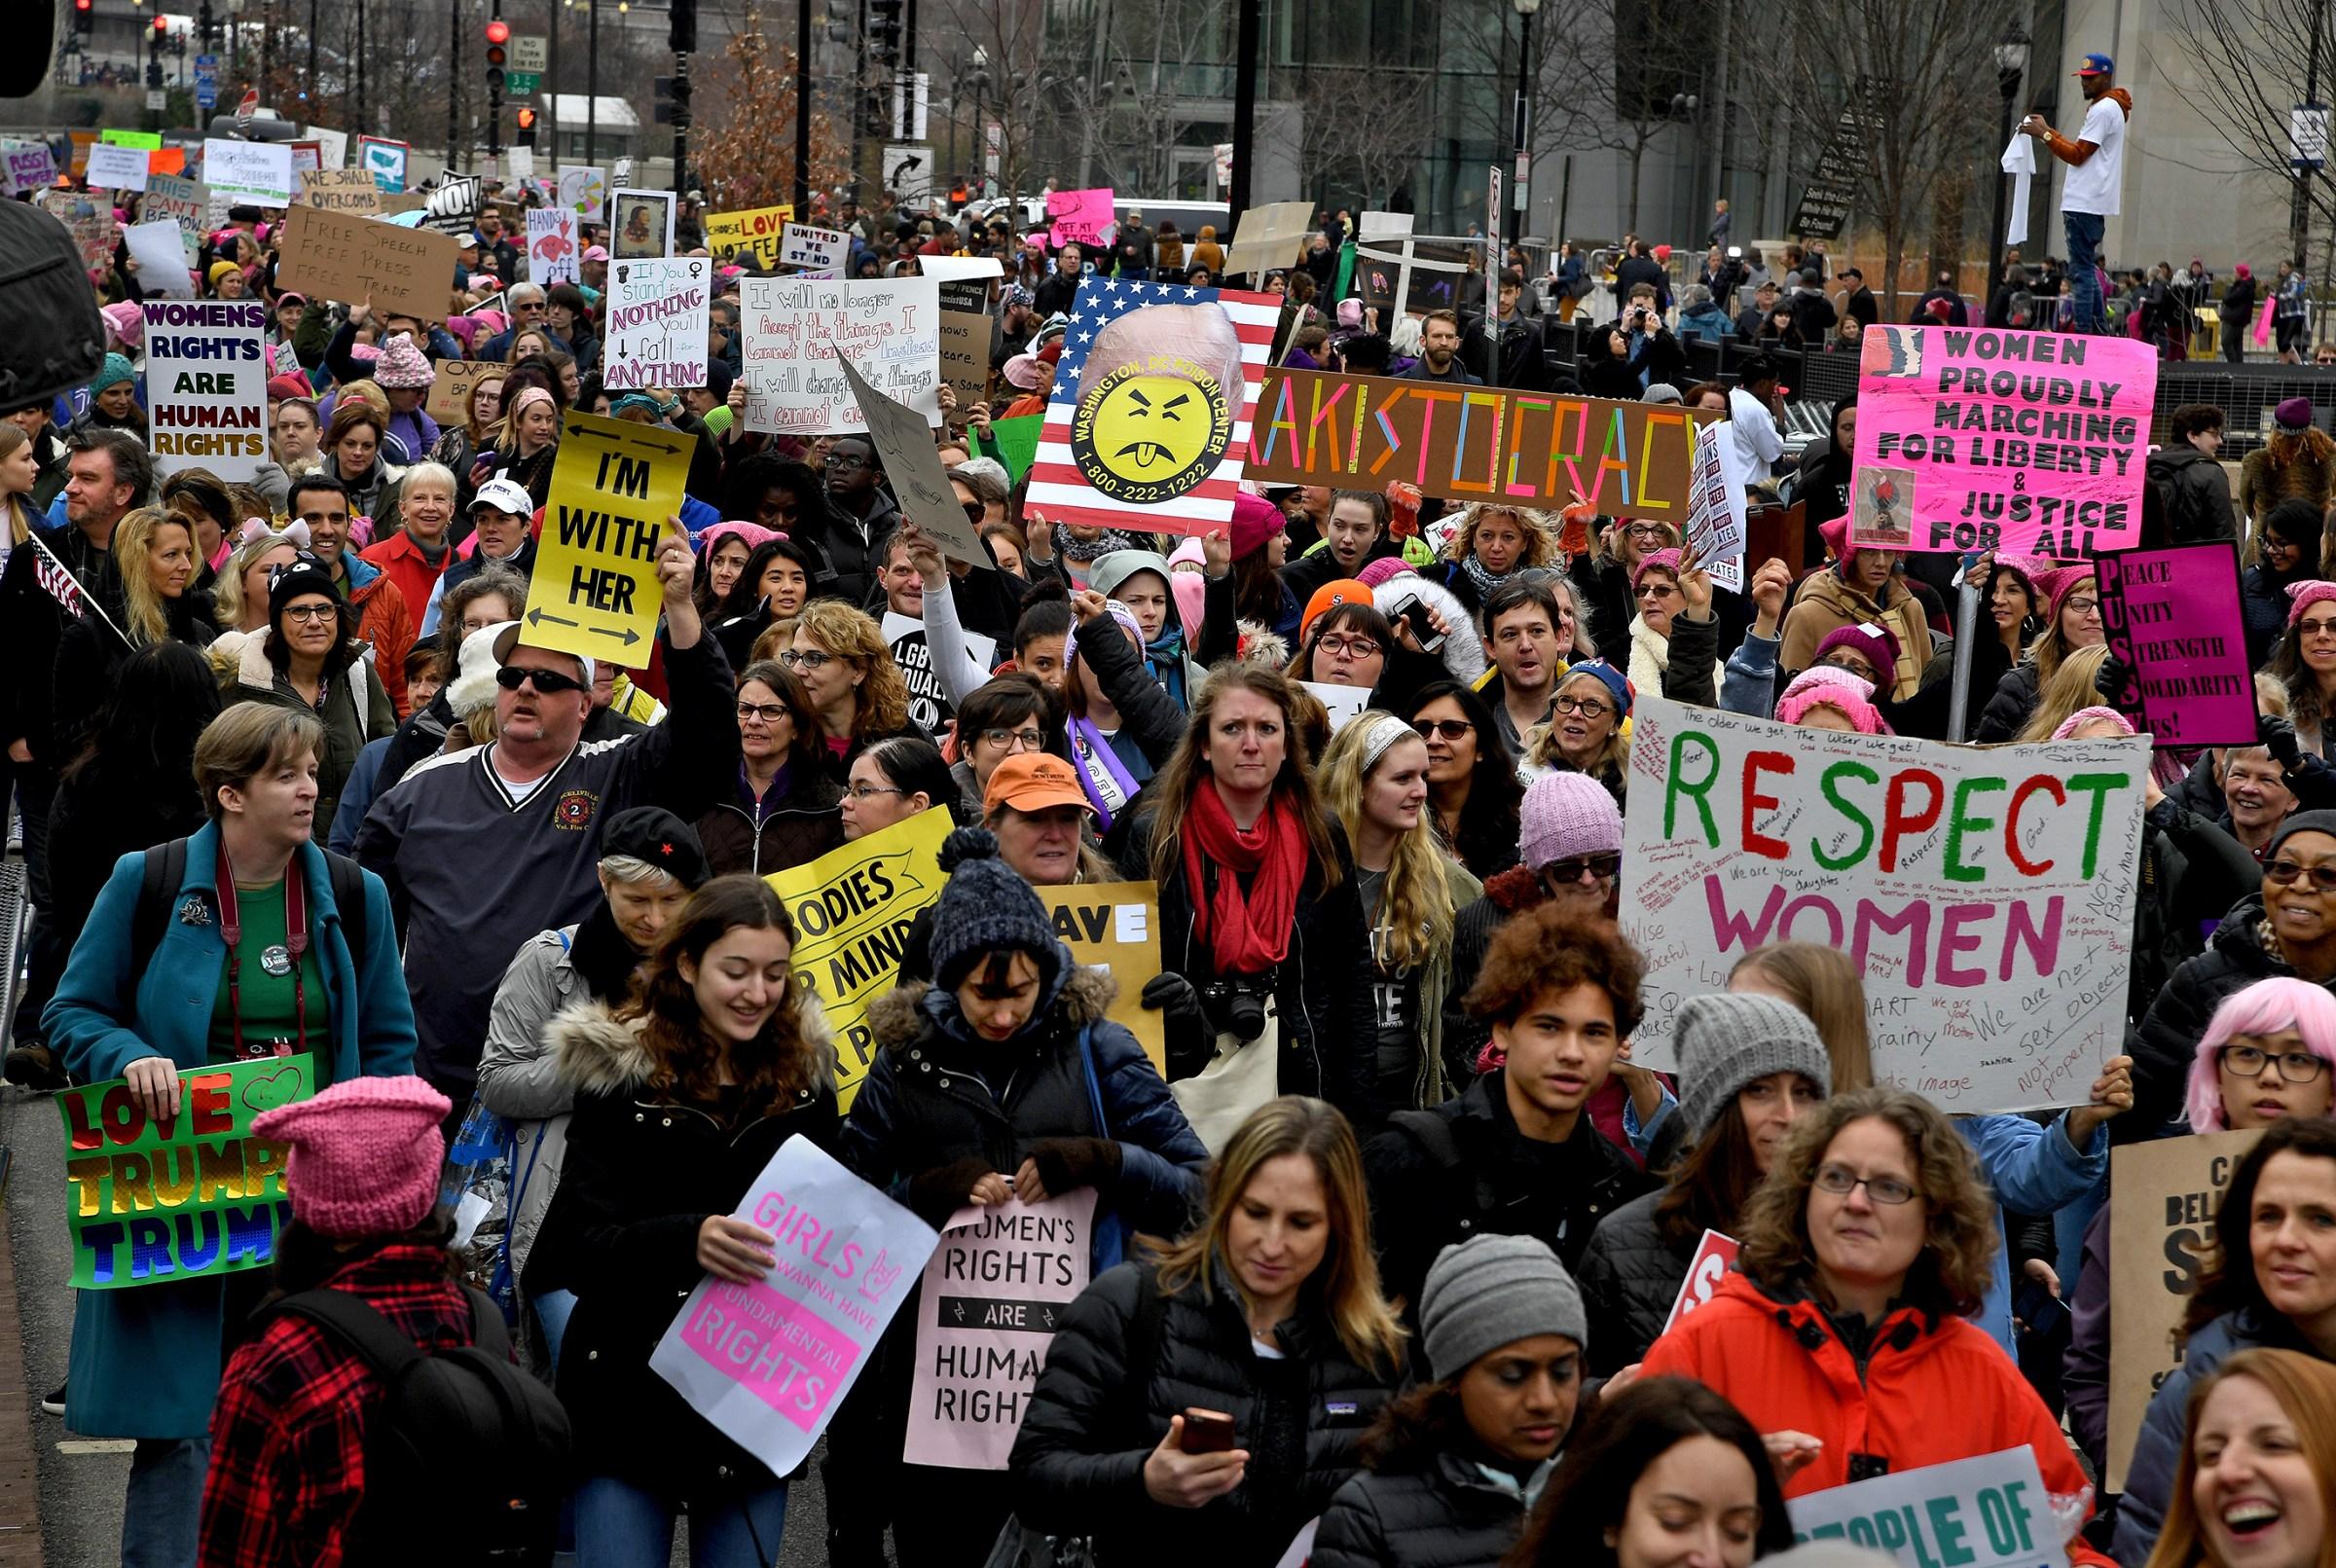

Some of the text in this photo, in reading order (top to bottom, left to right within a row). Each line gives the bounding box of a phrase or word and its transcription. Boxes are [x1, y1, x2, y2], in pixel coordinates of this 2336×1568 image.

[9, 150, 49, 172] PUSSY
[148, 175, 193, 200] THIS
[302, 169, 373, 186] WE SHALL
[146, 193, 202, 216] CAN'T
[427, 182, 472, 217] NO!
[304, 211, 352, 242] FREE
[529, 210, 562, 232] HANDS
[792, 228, 839, 243] UNITED
[300, 238, 348, 263] FREE
[790, 250, 830, 265] STAND
[805, 241, 821, 253] WE
[295, 264, 340, 286] FREE
[634, 263, 654, 279] If
[143, 303, 266, 328] WOMEN'S
[609, 288, 705, 334] NOTHING
[778, 283, 813, 310] will
[819, 291, 838, 310] no
[844, 283, 894, 318] longer
[806, 311, 832, 339] the
[834, 310, 894, 350] things
[939, 326, 968, 338] nows
[151, 336, 261, 361] RIGHTS
[638, 337, 674, 361] fall
[1944, 330, 2087, 366] WOMEN
[173, 372, 235, 394] ARE
[603, 358, 707, 389] ANYTHING
[766, 367, 800, 393] will
[888, 364, 932, 394] things
[1939, 367, 2122, 411] PROUDLY
[155, 404, 261, 428] HUMAN
[774, 397, 831, 425] cannot
[1174, 357, 1220, 397] POISON
[1207, 396, 1229, 456] CENTER
[1934, 401, 2137, 445] MARCHING
[154, 432, 265, 456] RIGHTS
[1250, 376, 1696, 511] AKISTOCRAC
[1878, 432, 2134, 476] FOR LIBERTY
[595, 452, 651, 500] I'M
[1078, 451, 1210, 501] 1-800-222-1222
[2013, 472, 2026, 492] &
[1960, 491, 2128, 530] JUSTICE
[559, 505, 661, 563] WITH
[1717, 526, 1738, 544] ATED
[1929, 521, 2001, 551] FOR
[2030, 529, 2099, 559] ALL
[568, 565, 637, 615] HER
[894, 640, 932, 671] LGB
[1682, 706, 1704, 725] The
[1708, 710, 1739, 730] older
[1745, 722, 1762, 735] we
[570, 804, 580, 816] 2
[1662, 730, 2131, 883] RESPECT
[1049, 904, 1148, 943] AVE
[1704, 873, 2064, 989] WOMEN
[1865, 996, 1917, 1017] ART
[752, 1190, 863, 1280] GIRLS
[944, 1248, 1074, 1287] RIGHTS
[776, 1259, 878, 1333] WANNA HAVE
[983, 1304, 1028, 1327] ARE
[693, 1302, 826, 1413] RIGHTS
[934, 1345, 1041, 1382] HUMA
[934, 1387, 1034, 1425] RIGH
[1976, 1479, 2034, 1557] OF
